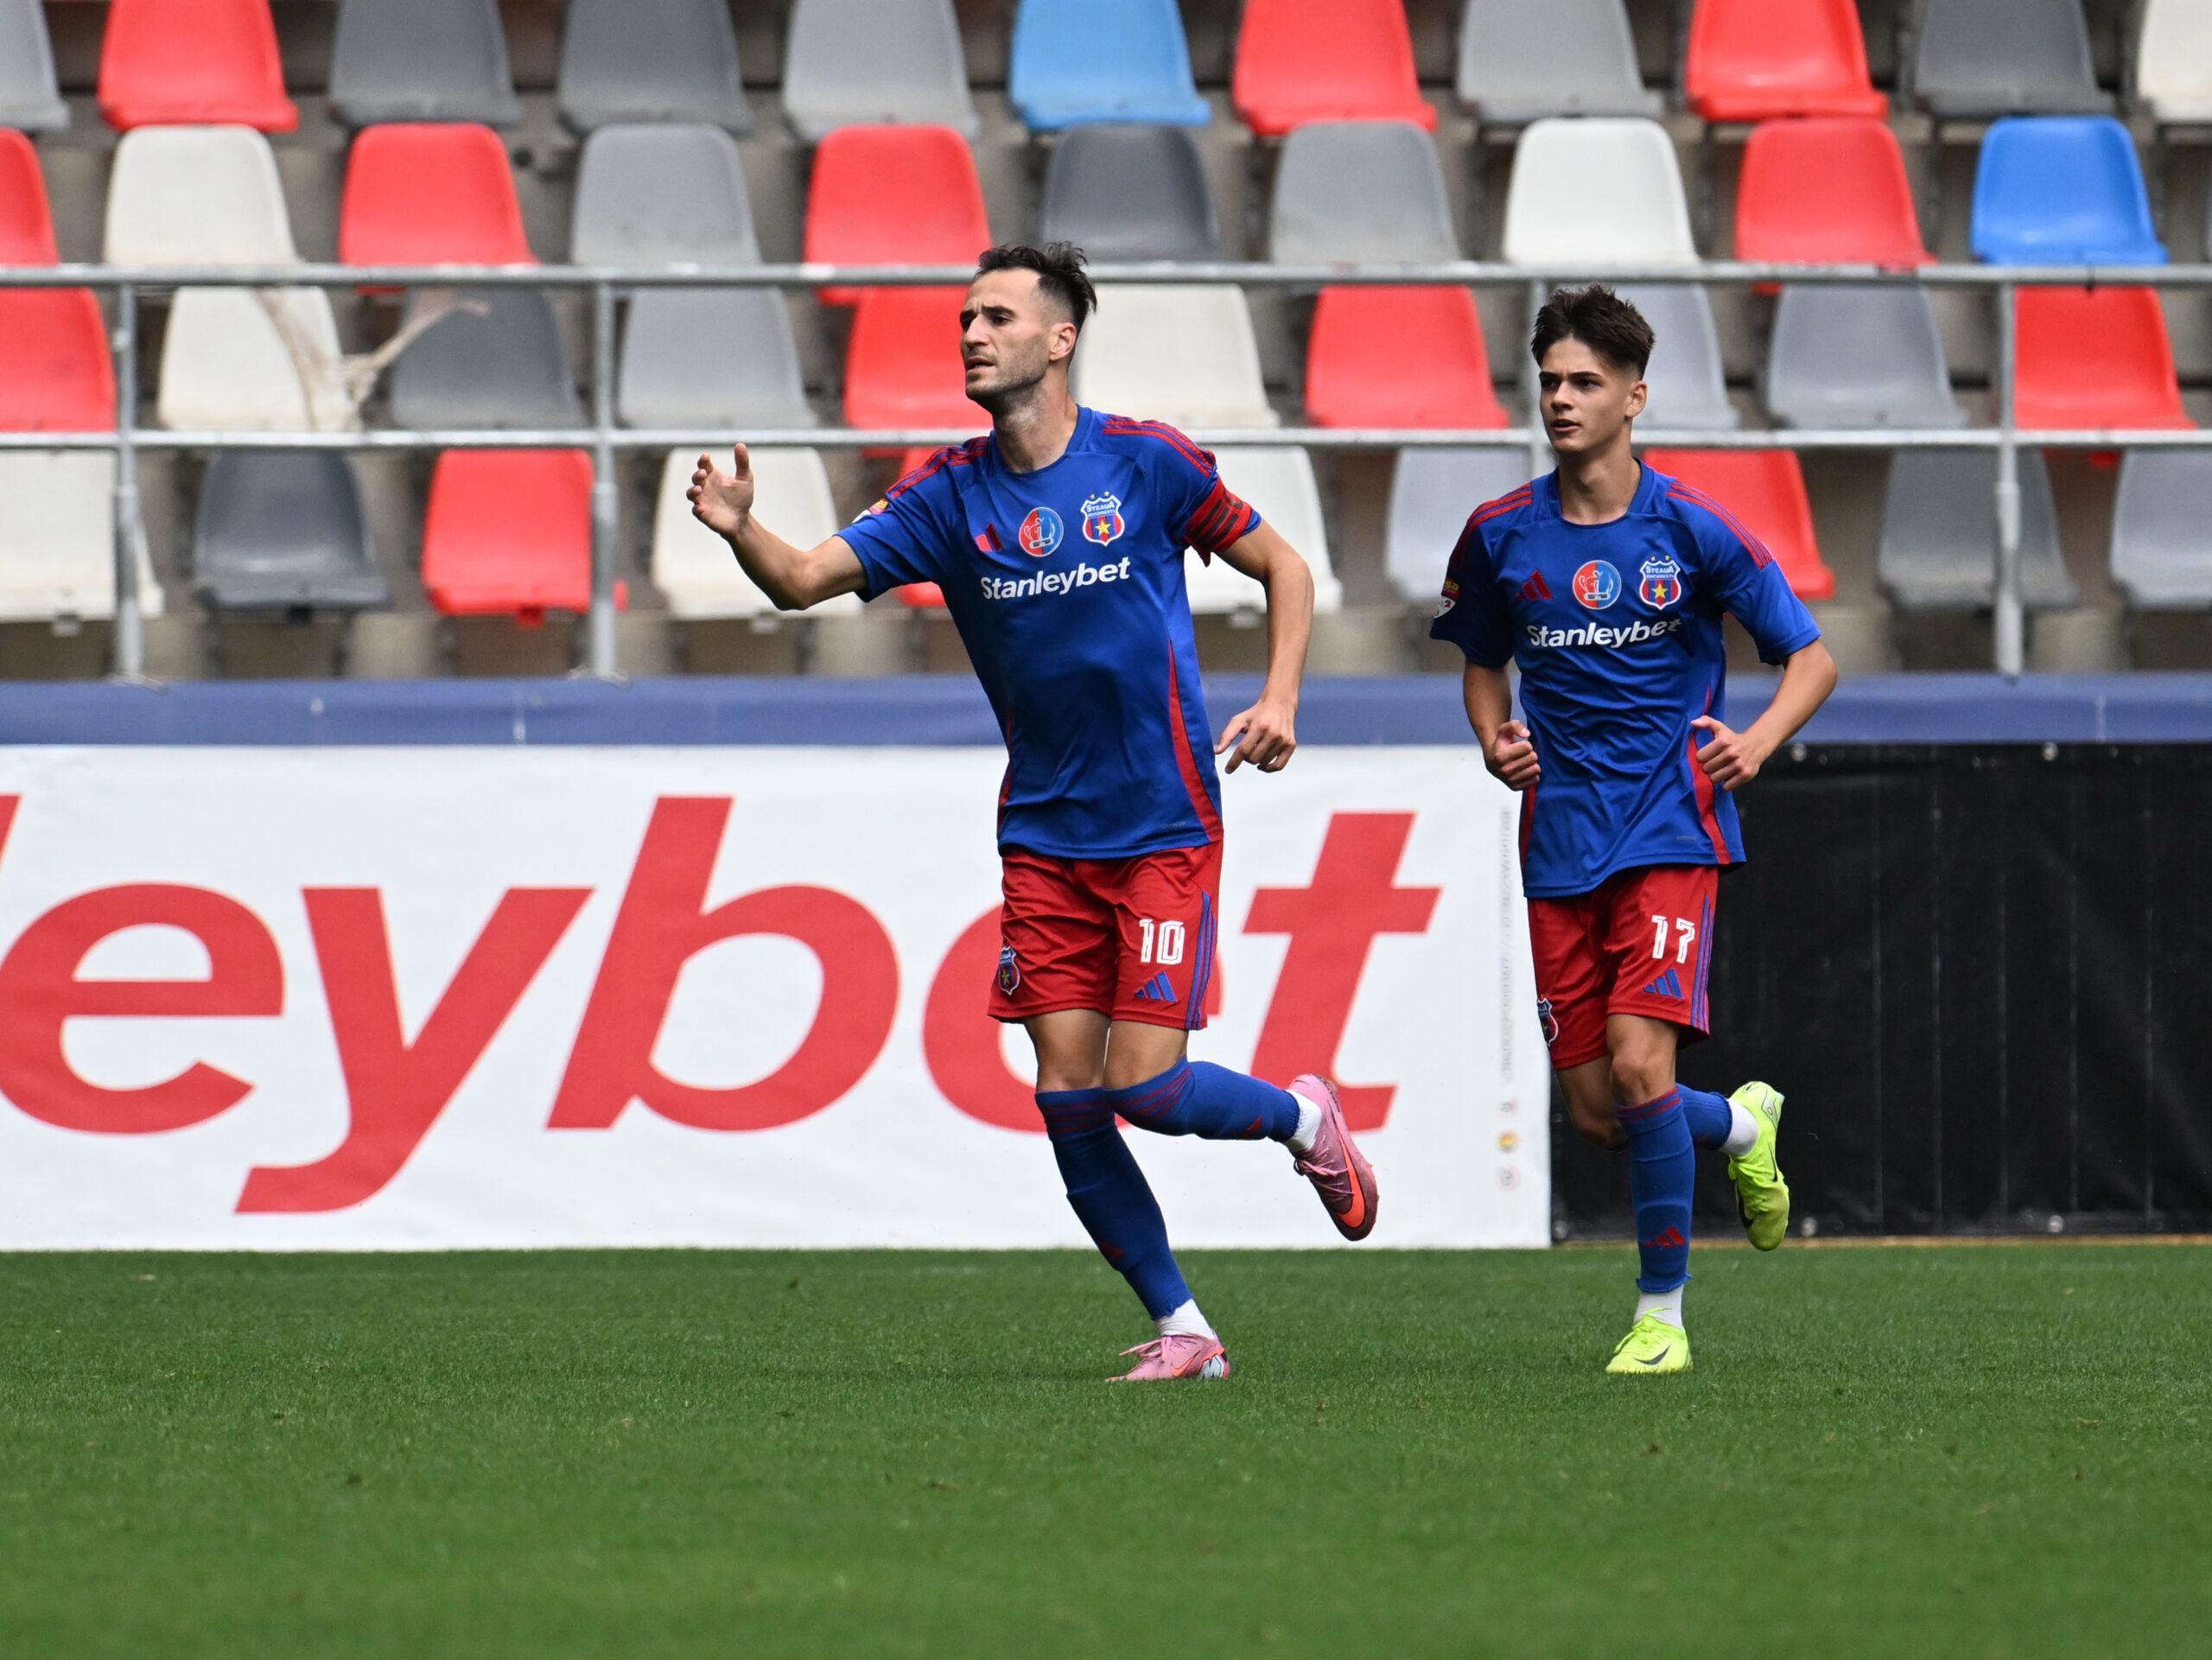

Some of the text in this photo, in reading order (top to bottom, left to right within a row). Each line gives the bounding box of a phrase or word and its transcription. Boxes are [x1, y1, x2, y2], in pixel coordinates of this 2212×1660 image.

[981, 557, 1130, 600] Stanleybet
[1526, 618, 1682, 649] Stanleybet
[1139, 919, 1185, 965] 10
[1651, 915, 1695, 964] 17
[0, 794, 1441, 1213] eybt
